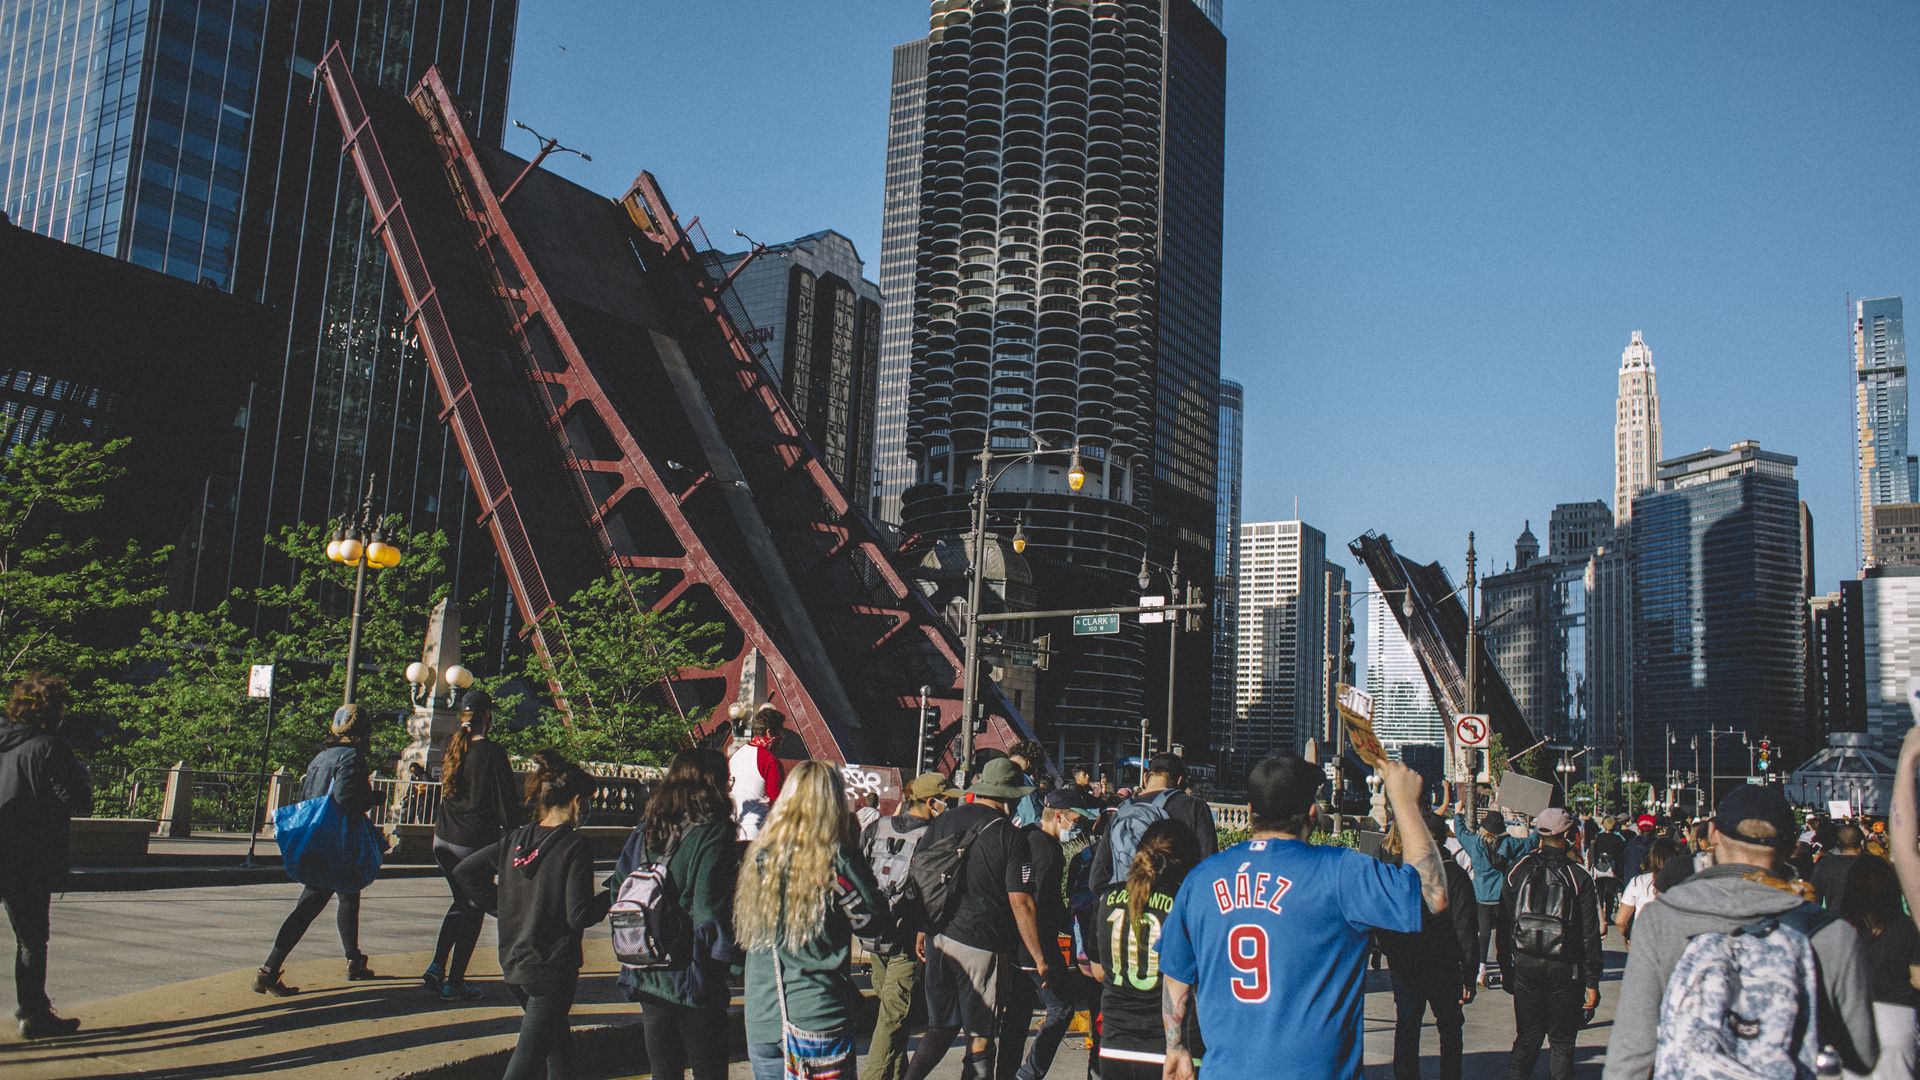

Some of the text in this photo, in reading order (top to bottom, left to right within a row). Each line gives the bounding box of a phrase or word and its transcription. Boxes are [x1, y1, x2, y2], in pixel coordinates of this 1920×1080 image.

[1082, 617, 1108, 626] CLARK
[1214, 862, 1293, 915] BÁEZ
[1107, 908, 1161, 991] 10
[1228, 924, 1271, 1004] 9
